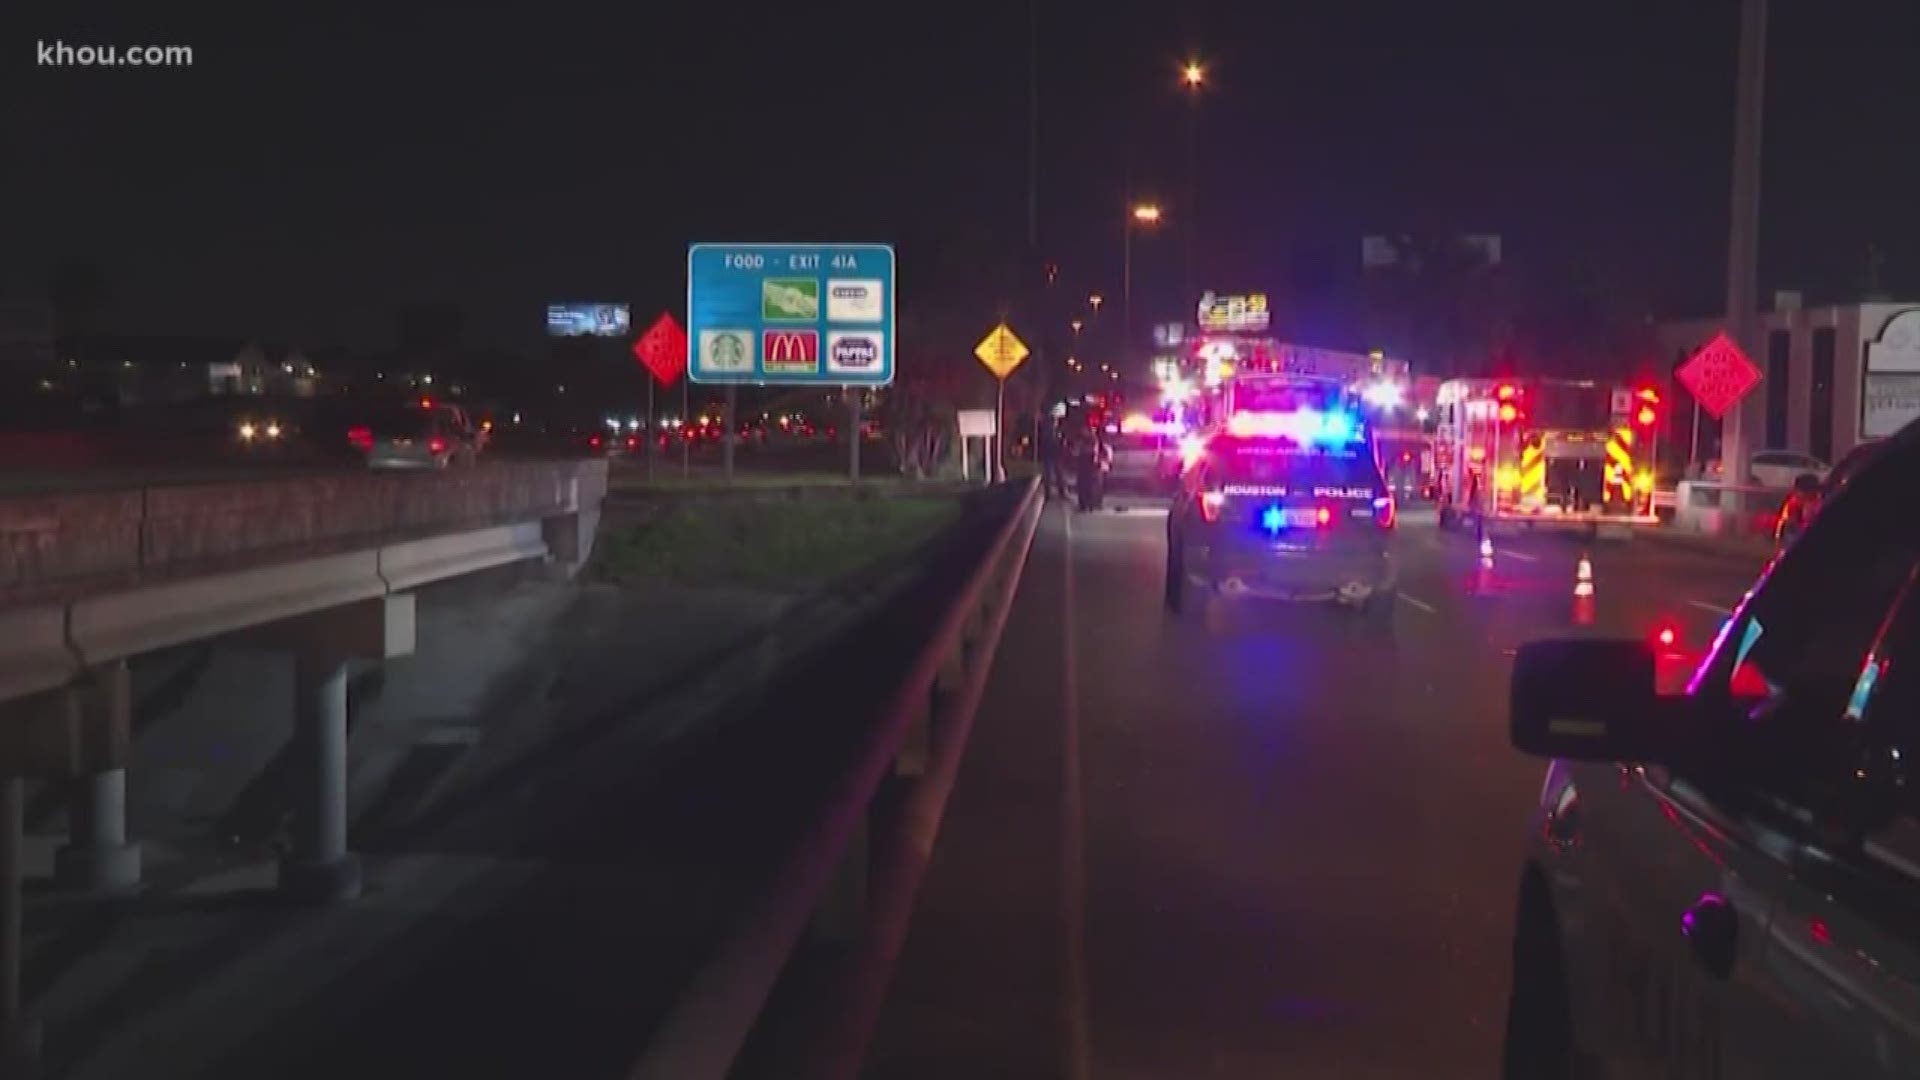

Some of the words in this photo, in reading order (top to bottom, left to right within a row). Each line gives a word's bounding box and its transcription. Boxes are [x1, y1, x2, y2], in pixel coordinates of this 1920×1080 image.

[725, 254, 764, 269] FOOD
[789, 254, 820, 269] EXIT
[831, 254, 858, 269] 41A
[1704, 352, 1738, 363] ROAD
[1223, 485, 1286, 496] HOUSTON
[1313, 486, 1373, 499] POLICE
